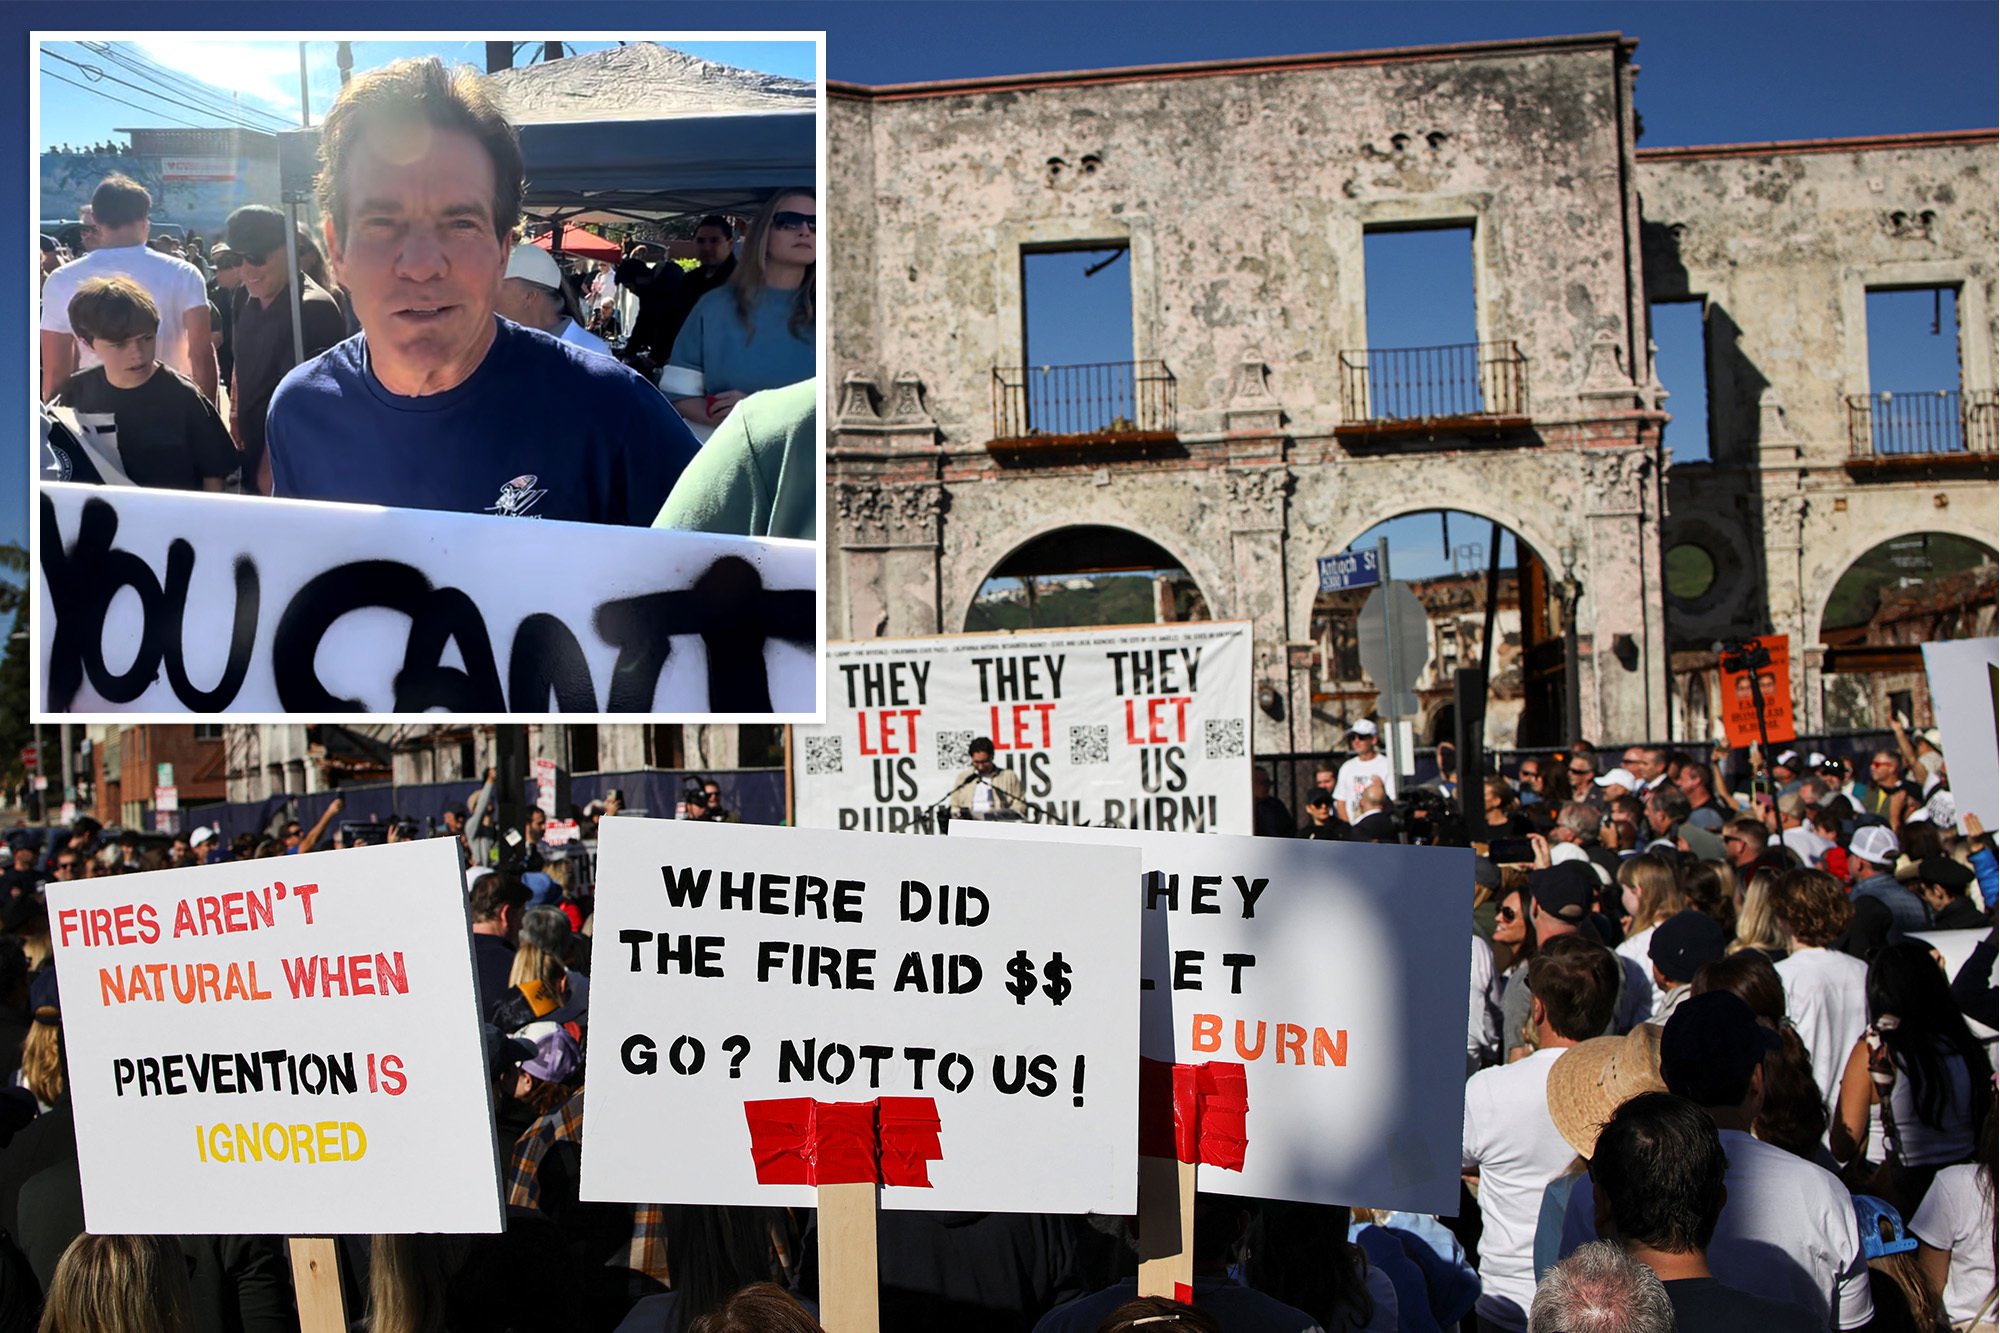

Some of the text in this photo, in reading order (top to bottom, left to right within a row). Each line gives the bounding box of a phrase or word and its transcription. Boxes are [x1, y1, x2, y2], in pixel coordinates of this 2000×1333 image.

[1320, 551, 1377, 577] Antioch St
[40, 490, 260, 713] YOU
[839, 660, 931, 708] THEY
[971, 653, 1066, 702] THEY
[1106, 646, 1202, 696] THEY
[858, 709, 922, 755] LET
[990, 703, 1056, 751] LET
[1125, 697, 1192, 745] LET
[873, 757, 919, 803] US
[1140, 746, 1188, 794] US
[1104, 795, 1217, 834] BURN!
[59, 882, 319, 948] FIRES AREN'T
[661, 865, 990, 927] WHERE DID
[1146, 871, 1270, 920] HEY
[99, 951, 410, 1006] NATURAL WHEN
[619, 930, 1073, 1006] THE FIRE AID $$
[1192, 1013, 1348, 1067] BURN
[114, 1049, 408, 1097] PREVENTION IS
[779, 1037, 894, 1086] NOT
[903, 1046, 975, 1094] TO
[196, 1121, 367, 1164] IGNORED
